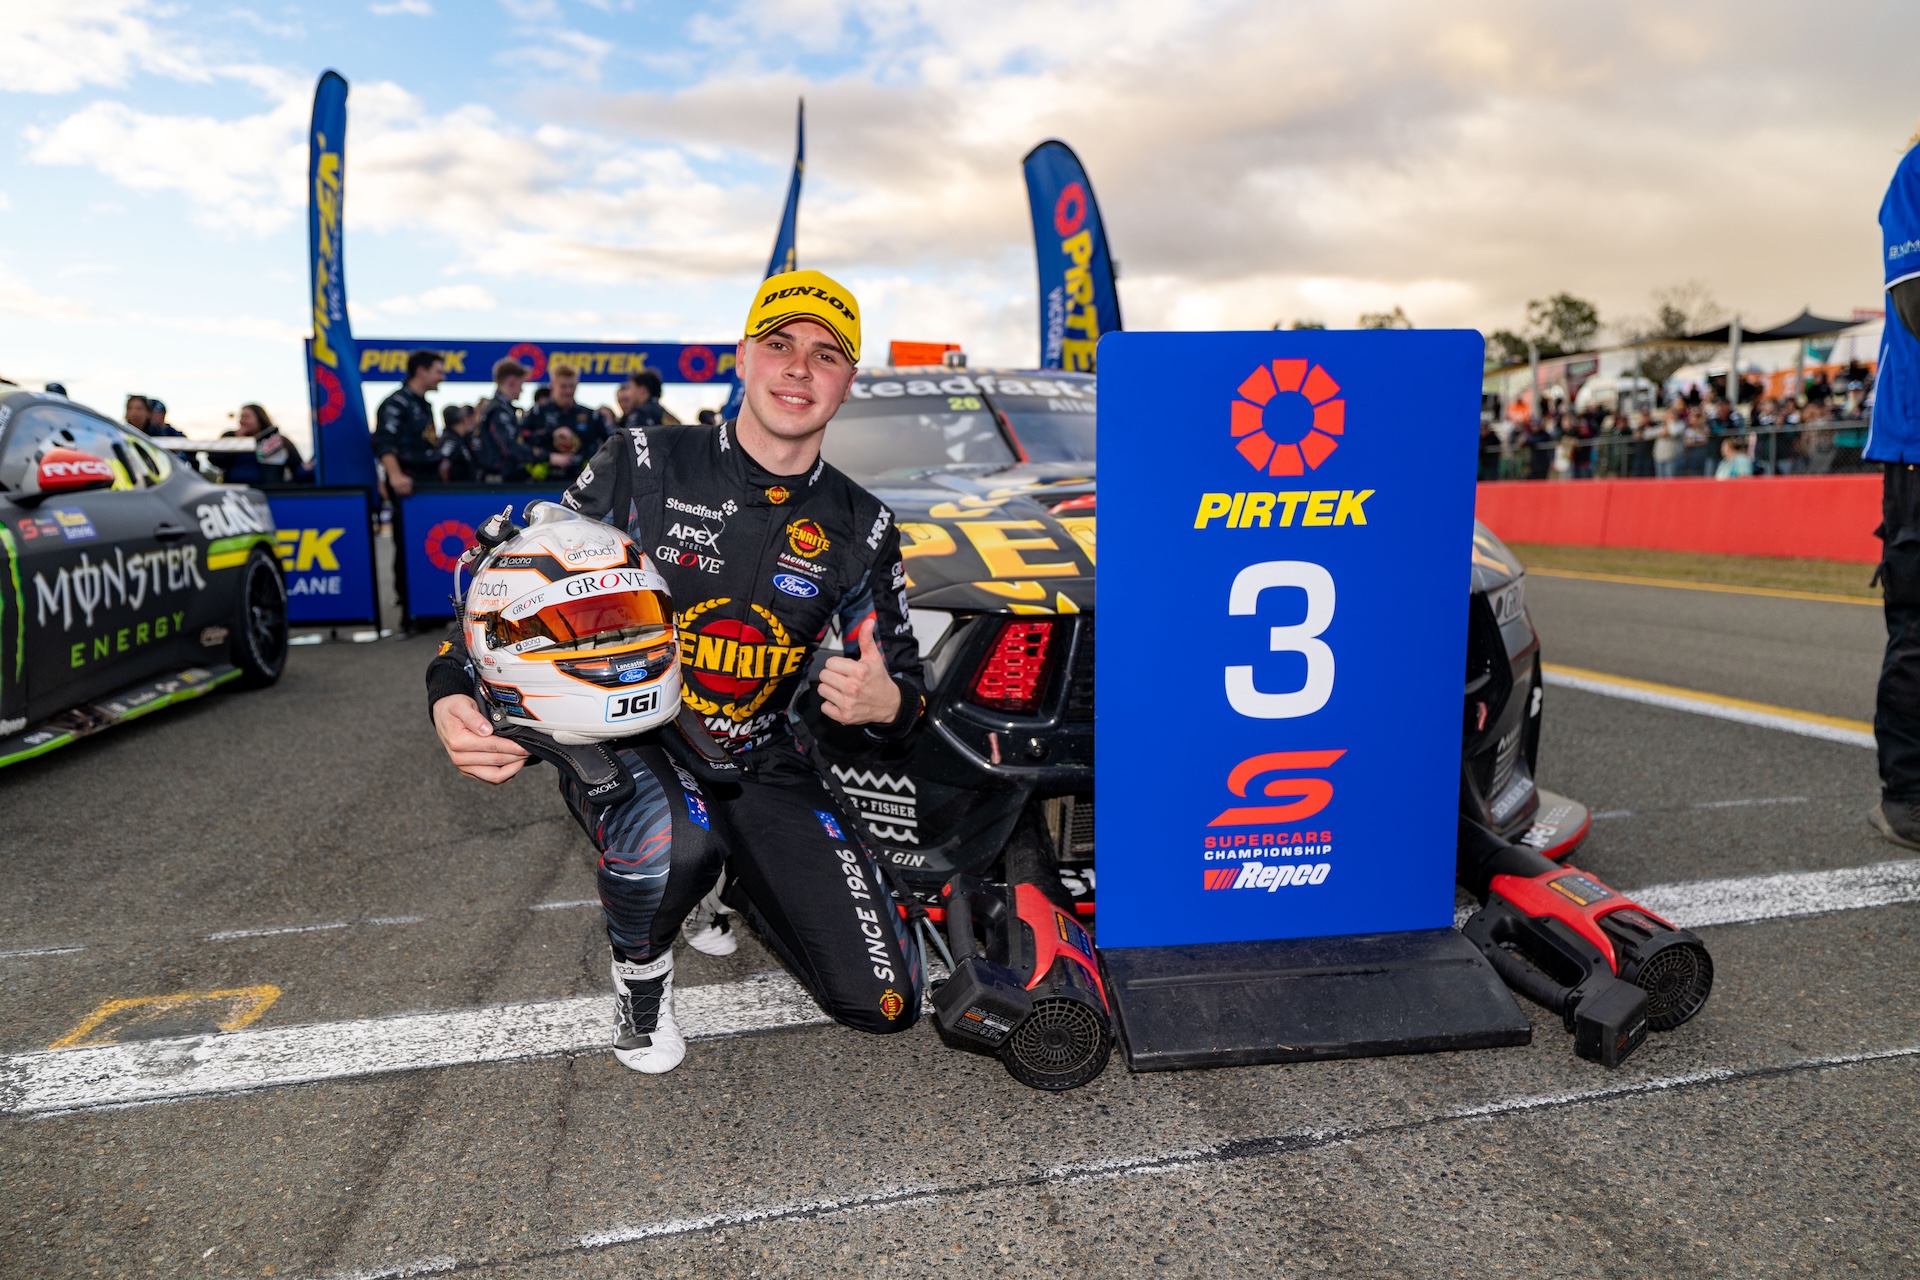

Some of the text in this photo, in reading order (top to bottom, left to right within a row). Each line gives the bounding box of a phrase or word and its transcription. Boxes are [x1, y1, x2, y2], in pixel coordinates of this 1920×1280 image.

[761, 286, 856, 321] DUNLOP
[1061, 229, 1099, 373] PIRTE
[359, 349, 466, 375] PIRK
[849, 375, 1083, 400] teadfast
[629, 427, 652, 470] HRX
[765, 488, 790, 499] PENRITE
[665, 498, 724, 522] Steadfast
[1193, 489, 1376, 529] PIRTEK
[667, 522, 722, 555] APEX
[786, 524, 831, 551] PENRITE
[866, 505, 892, 550] HRX
[567, 545, 617, 561] airtouch
[679, 540, 704, 552] STEEL
[779, 552, 812, 569] RACING
[565, 571, 649, 597] GROVE
[780, 576, 812, 596] Ford
[512, 593, 545, 615] GROVE
[71, 611, 185, 669] ENERGY
[1224, 560, 1336, 720] 3
[615, 660, 647, 671] Lancaster
[680, 630, 807, 679] ENRITE
[625, 669, 643, 681] Ford
[611, 690, 658, 718] JGI
[588, 780, 620, 797] EXGEL
[871, 800, 916, 819] FISHER
[1204, 830, 1333, 849] SUPERCARS
[1204, 844, 1333, 861] CHAMPIONSHIP
[892, 850, 926, 868] GIN
[1232, 861, 1332, 893] Repco
[835, 849, 896, 984] SINCE 1926
[885, 988, 896, 1021] PENRITE
